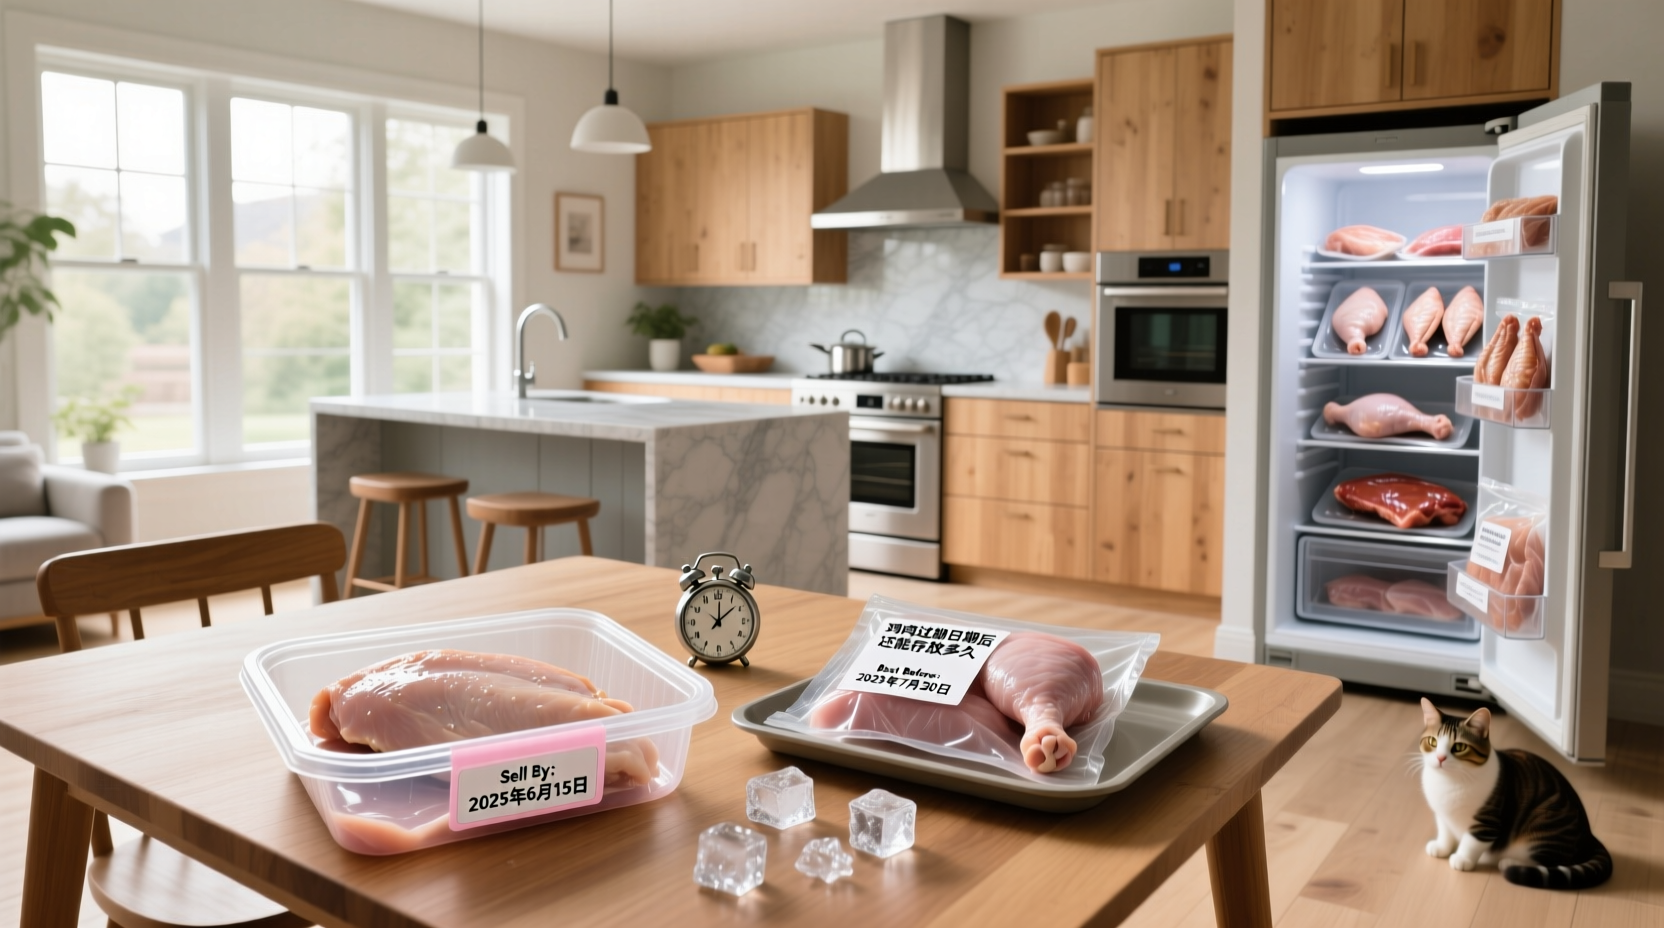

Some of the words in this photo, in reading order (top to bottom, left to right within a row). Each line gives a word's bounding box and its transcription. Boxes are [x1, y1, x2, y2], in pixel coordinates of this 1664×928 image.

[500, 765, 528, 784] Sell
[532, 764, 556, 782] By:
[468, 776, 588, 812] 2025年6月15日
